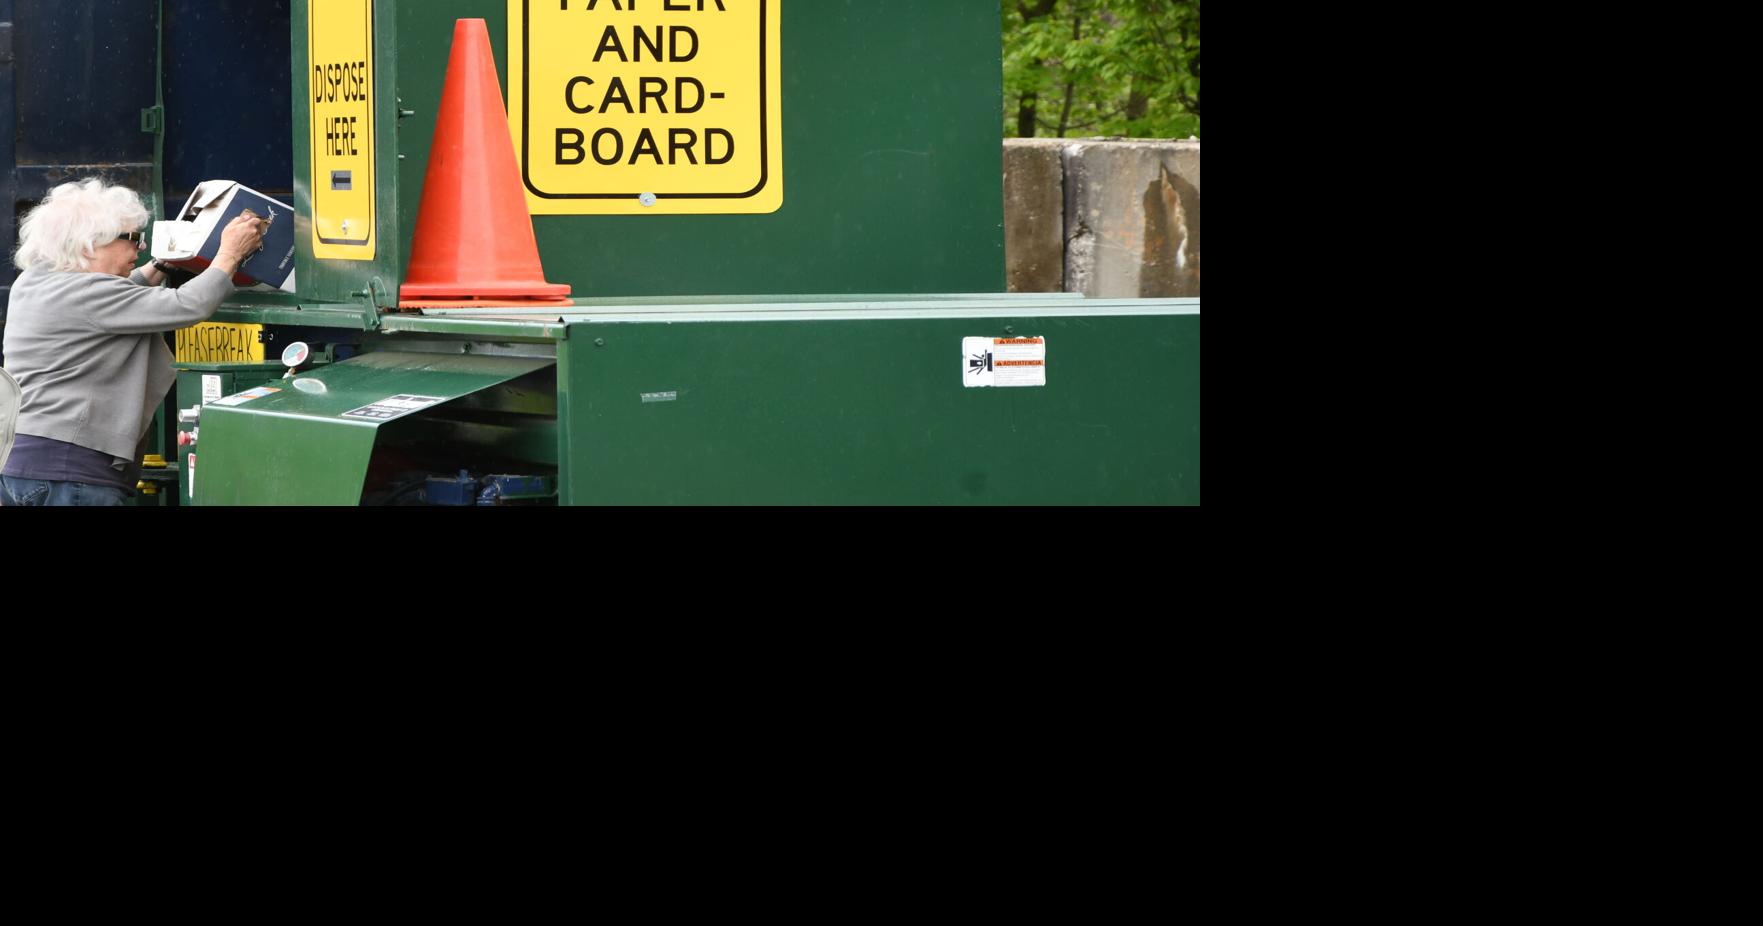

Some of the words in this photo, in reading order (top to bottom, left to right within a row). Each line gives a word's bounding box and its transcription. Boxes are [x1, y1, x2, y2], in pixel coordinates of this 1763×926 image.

[592, 25, 699, 63] AND
[315, 61, 366, 103] DISPOSE
[565, 76, 725, 114] CARD-
[326, 116, 358, 156] HERE
[555, 127, 735, 166] BOARD
